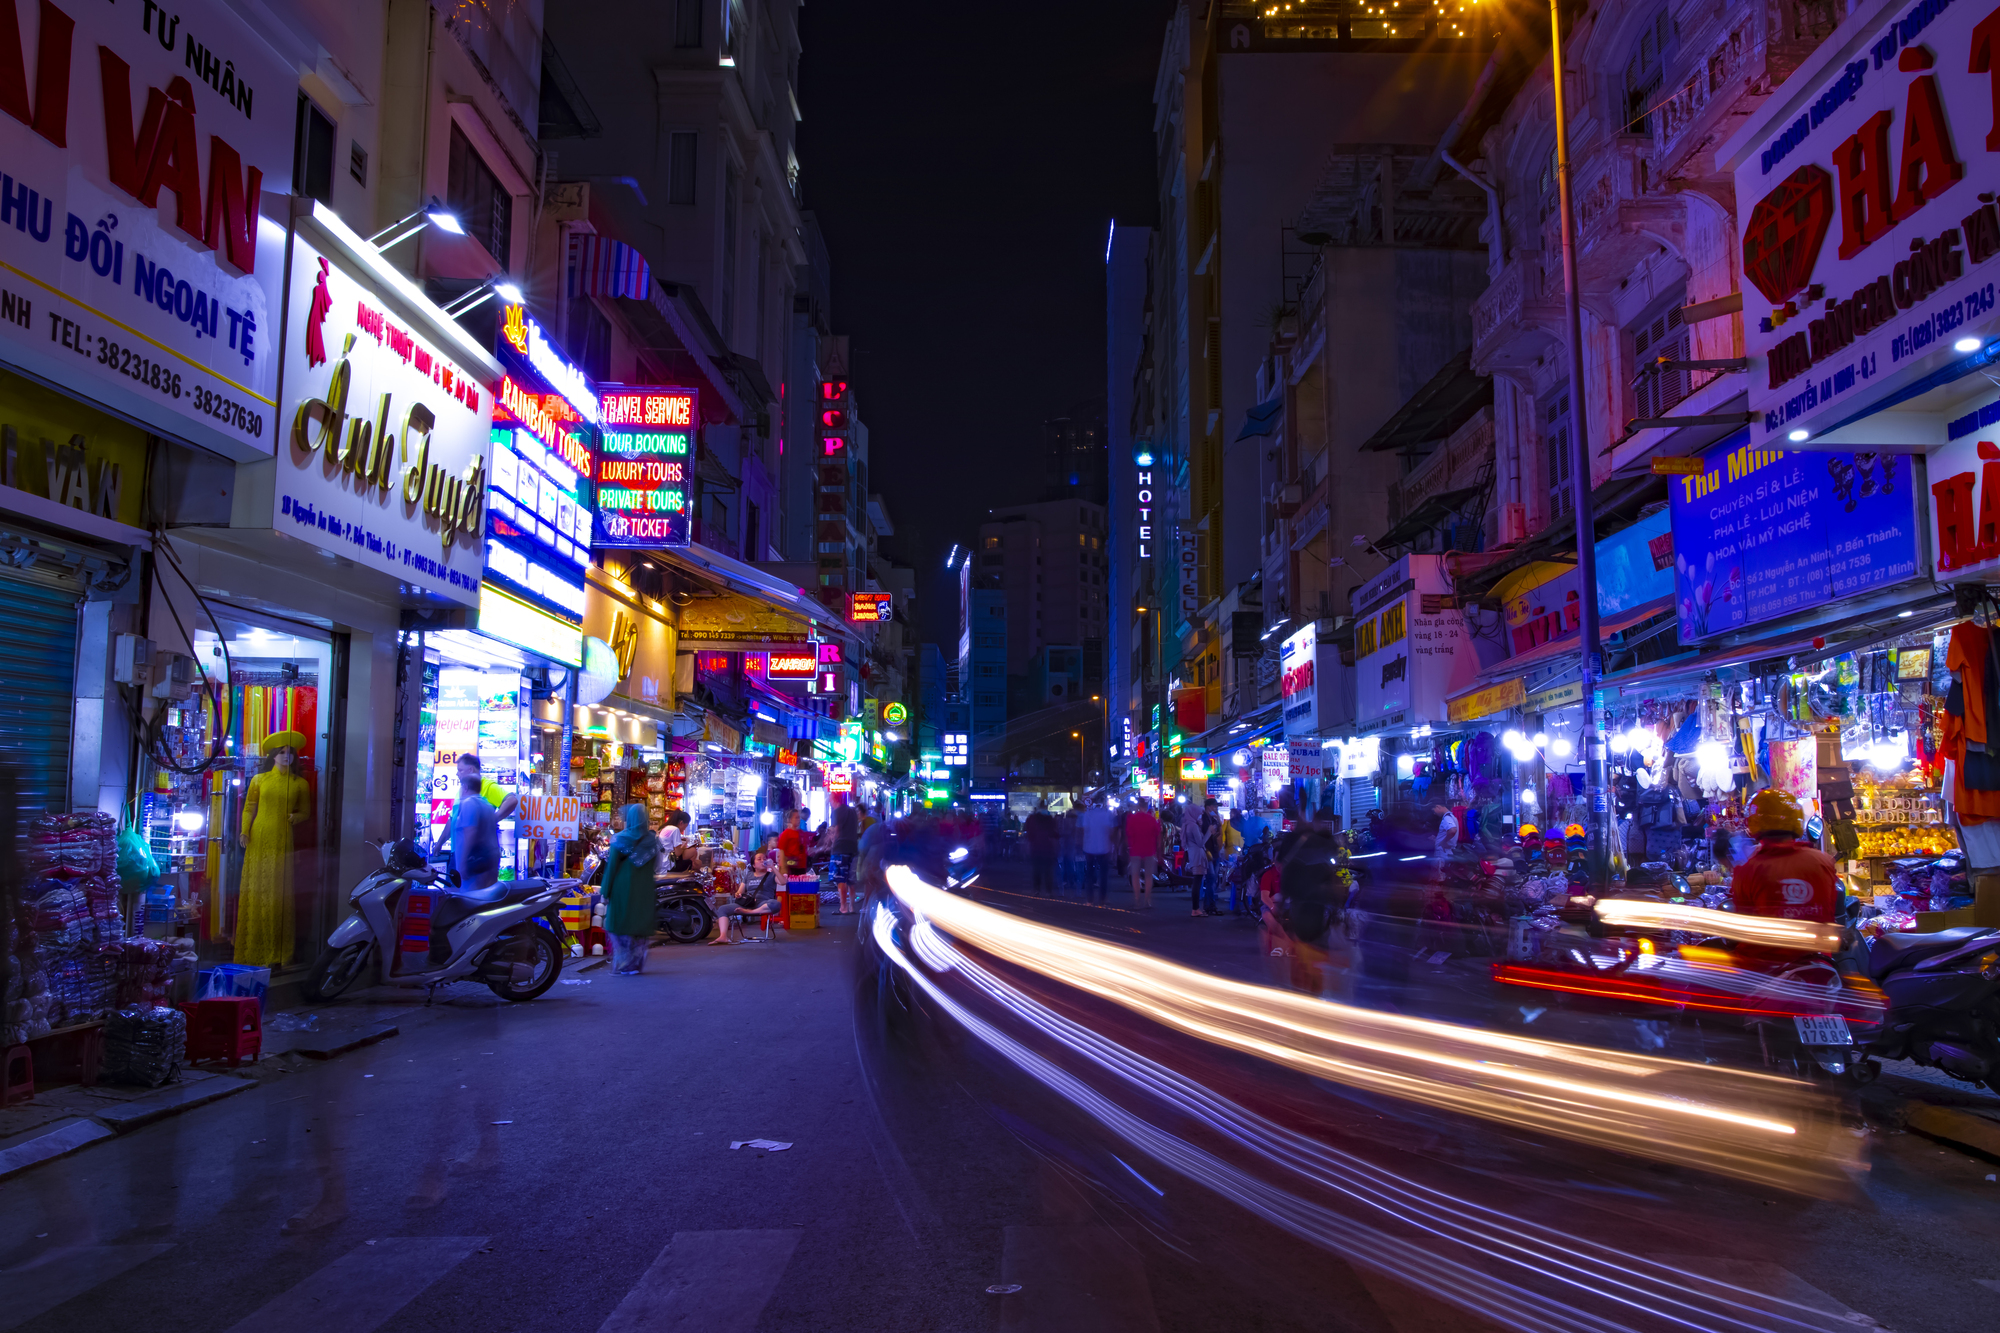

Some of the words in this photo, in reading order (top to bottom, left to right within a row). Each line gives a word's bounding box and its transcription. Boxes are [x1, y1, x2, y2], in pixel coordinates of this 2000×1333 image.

[185, 33, 253, 120] NHÂN
[1761, 113, 1810, 175] DOANH
[1870, 22, 1899, 71] TƯ
[97, 45, 263, 274] VÂN
[1832, 45, 1963, 260] HÀ
[0, 171, 52, 243] HU
[65, 213, 123, 287] ĐỔI
[134, 253, 219, 339] NGOẠI
[226, 310, 257, 367] TỆ
[1767, 331, 1811, 390] MUA
[1808, 298, 1854, 364] BÁN
[1892, 228, 1962, 309] CÔNG
[97, 337, 182, 399] 38231836
[193, 384, 263, 438] 38237630
[501, 375, 556, 447] RAINBOW
[558, 425, 591, 478] TOURS
[602, 396, 643, 424] TRAVEL
[645, 396, 691, 425] SERVICE
[602, 433, 633, 452] TOUR
[635, 433, 687, 454] BOOKING
[602, 461, 644, 481] LUXURY
[644, 462, 682, 482] TOURS
[1681, 468, 1720, 504] Thu
[600, 490, 643, 509] PRIVATE
[644, 490, 683, 510] TOURS
[1138, 471, 1152, 558] HOTEL
[1710, 490, 1753, 520] CHUYÊN
[1756, 482, 1768, 501] SỈ
[1770, 480, 1781, 494] &
[1714, 525, 1735, 541] PHA
[1737, 515, 1750, 532] LÊ
[1760, 503, 1784, 522] LƯU
[1786, 487, 1819, 511] NIỆM
[609, 518, 628, 537] AIR
[630, 519, 669, 537] TICKET
[1715, 545, 1736, 561] HOA
[1738, 533, 1756, 551] VẢI
[1759, 526, 1774, 543] MỸ
[1778, 513, 1811, 538] NGHỆ
[1182, 535, 1198, 611] HOTEL
[1764, 560, 1795, 581] Nguyễn
[1797, 557, 1808, 568] An
[1800, 585, 1816, 600] Thu
[1859, 573, 1871, 585] 97
[1873, 568, 1886, 582] 27
[1888, 560, 1914, 577] Minh
[1848, 554, 1872, 570] 7536
[1414, 617, 1432, 627] Nhận
[1434, 618, 1445, 628] gia
[1446, 617, 1464, 628] công
[1415, 631, 1432, 640] vàng
[1434, 630, 1443, 639] 18
[1449, 630, 1459, 639] 24
[1416, 646, 1432, 656] vàng
[1434, 643, 1454, 655] trắng
[1264, 752, 1278, 760] SALE
[519, 796, 542, 822] SIM
[544, 796, 578, 823] CARD
[522, 825, 544, 838] 3G
[550, 826, 573, 840] 4G
